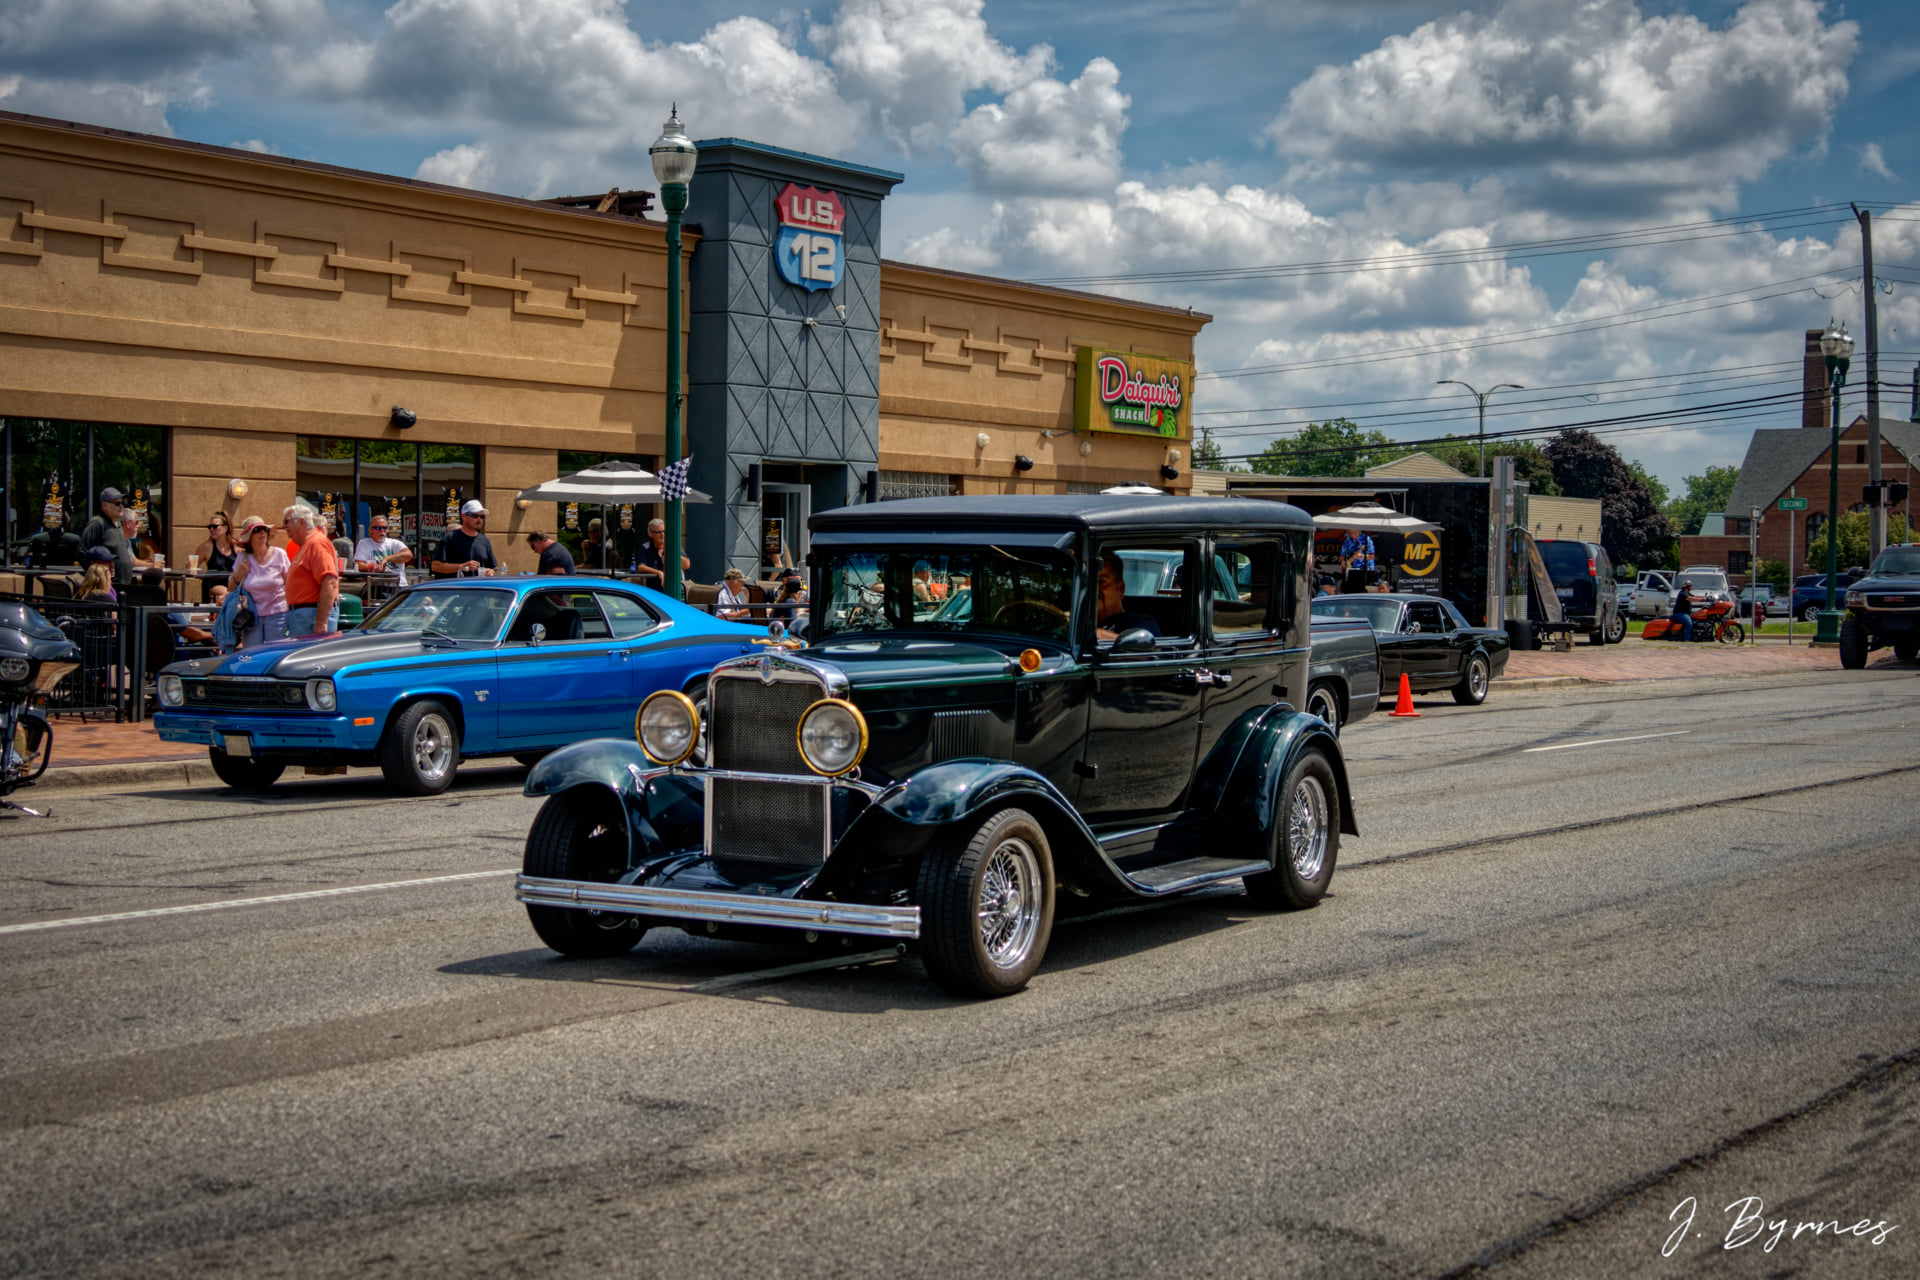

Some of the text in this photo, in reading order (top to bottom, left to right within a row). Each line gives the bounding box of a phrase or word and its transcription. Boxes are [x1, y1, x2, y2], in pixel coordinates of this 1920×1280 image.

[791, 195, 837, 226] U.S.
[790, 233, 836, 282] 12
[1098, 356, 1181, 422] Daiquiri
[1114, 408, 1144, 421] SHACK
[1782, 500, 1803, 508] SECOND
[1404, 543, 1434, 560] MF
